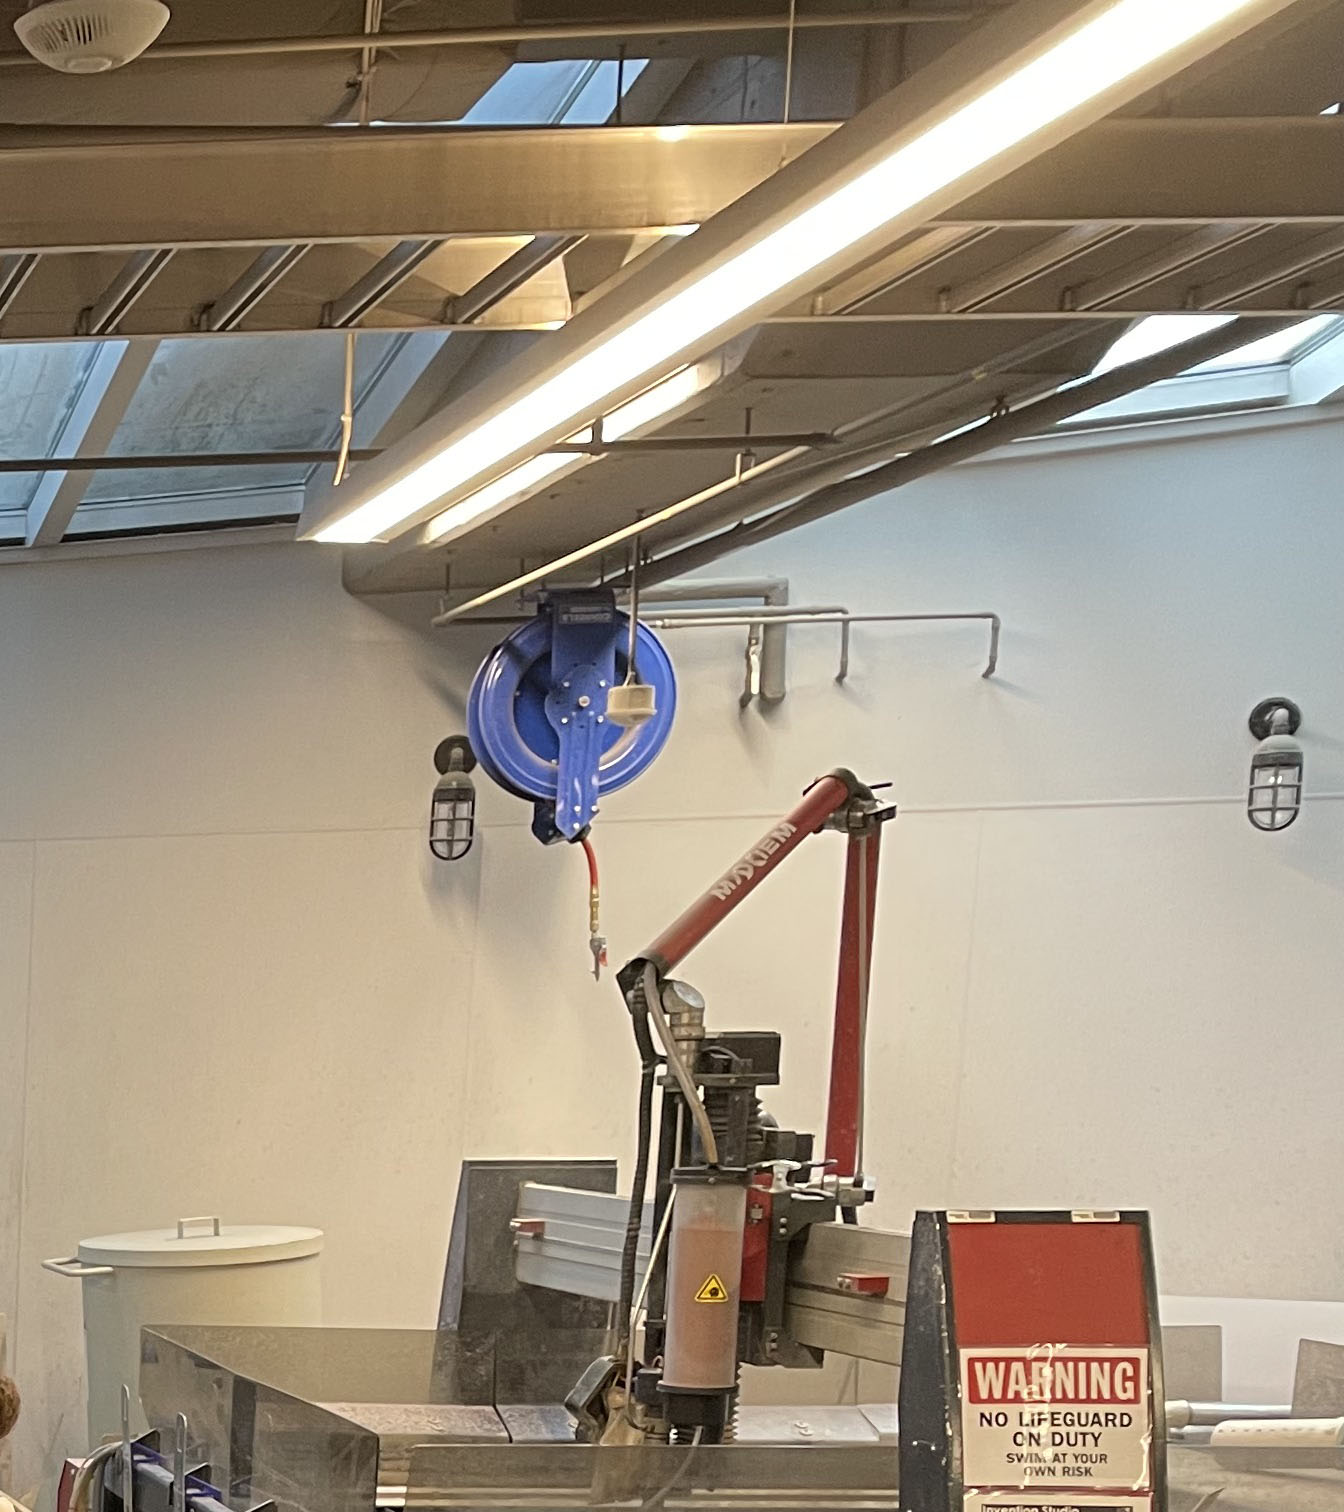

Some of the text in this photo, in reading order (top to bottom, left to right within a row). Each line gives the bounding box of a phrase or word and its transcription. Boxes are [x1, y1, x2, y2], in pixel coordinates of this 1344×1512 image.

[709, 822, 797, 901] MAXIEM
[974, 1360, 1135, 1400] WARNING
[979, 1411, 1133, 1428] NO LIFEGUARD
[1012, 1431, 1103, 1447] ON DUTY
[1052, 1453, 1069, 1464] AT
[1073, 1453, 1108, 1464] YOUR
[1023, 1466, 1094, 1477] OWN RISK
